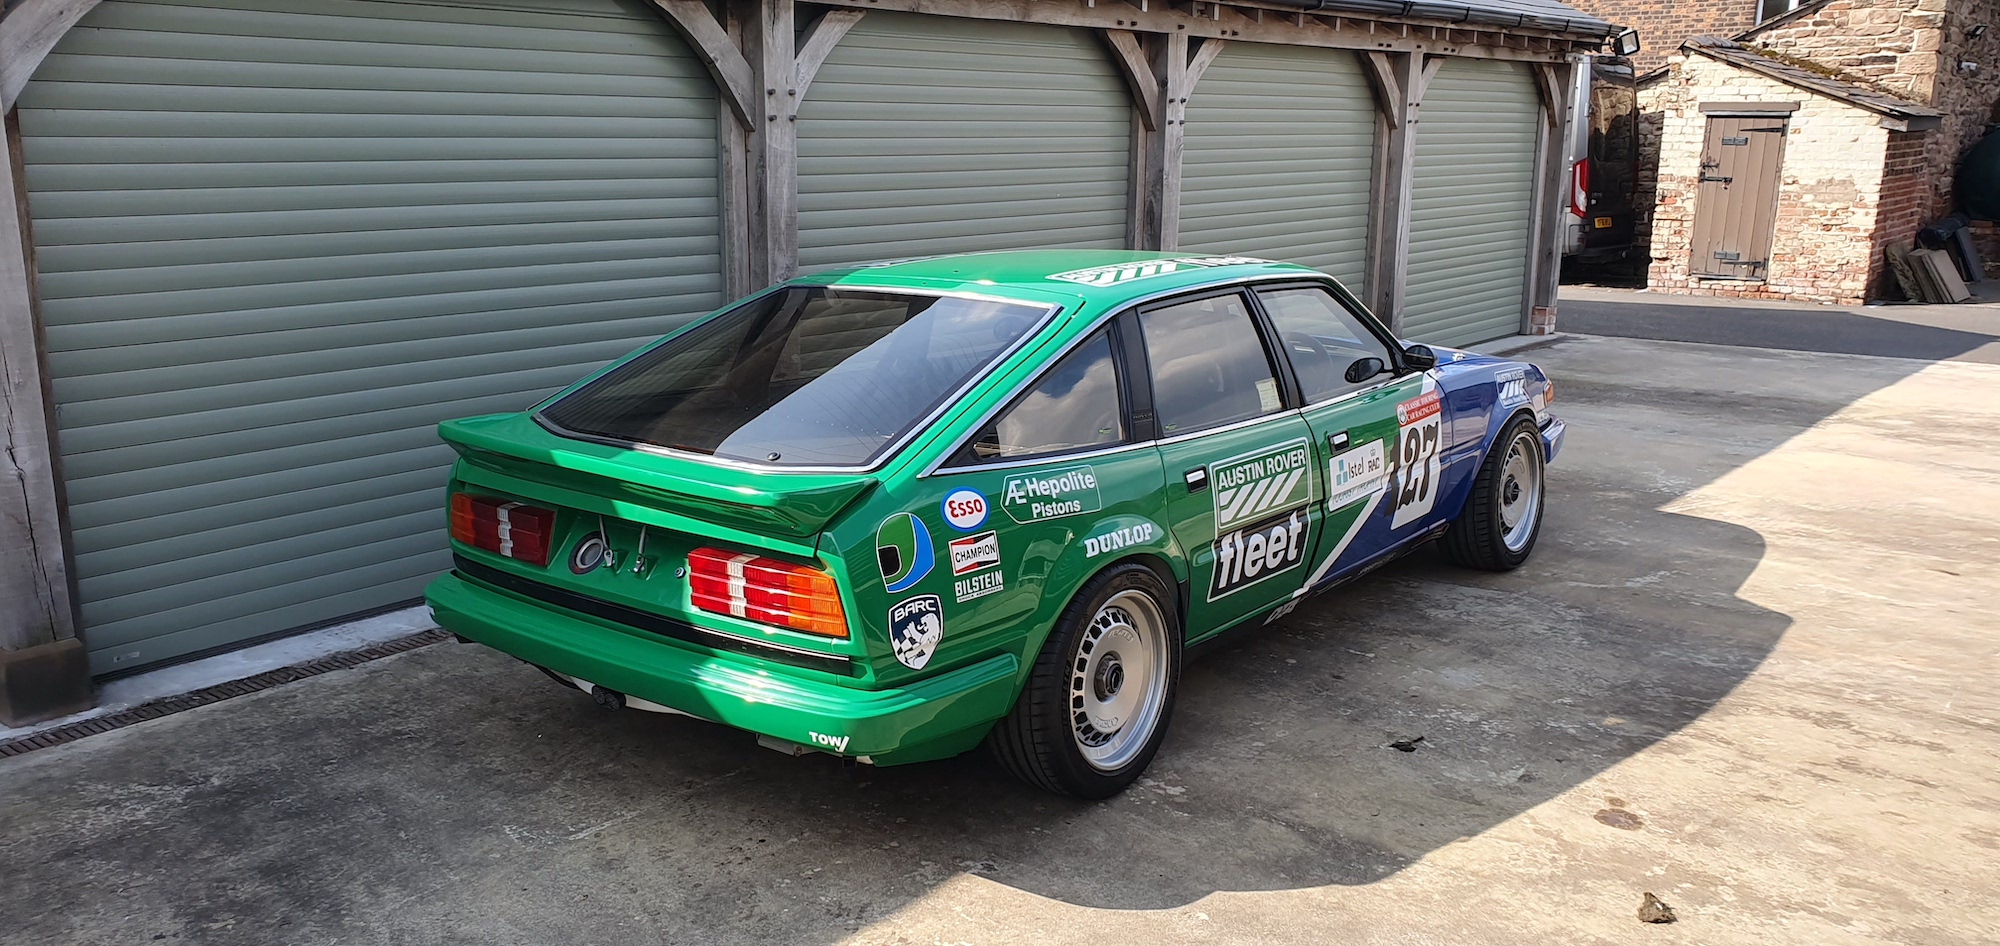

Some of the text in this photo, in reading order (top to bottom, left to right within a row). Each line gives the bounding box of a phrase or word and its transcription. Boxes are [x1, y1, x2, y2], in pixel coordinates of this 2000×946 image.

[1218, 449, 1306, 490] AUSTIN ROVER
[1348, 456, 1380, 480] Istel RAC
[1384, 421, 1439, 517] 127
[1026, 471, 1096, 500] Hepolite
[1032, 499, 1081, 518] Pistons
[955, 543, 996, 563] CHAMPION
[1084, 522, 1153, 558] DUNLOP
[1218, 510, 1302, 589] fleet
[955, 570, 1003, 597] BILSTEIN
[894, 600, 936, 623] BARC
[809, 731, 842, 747] TOW
